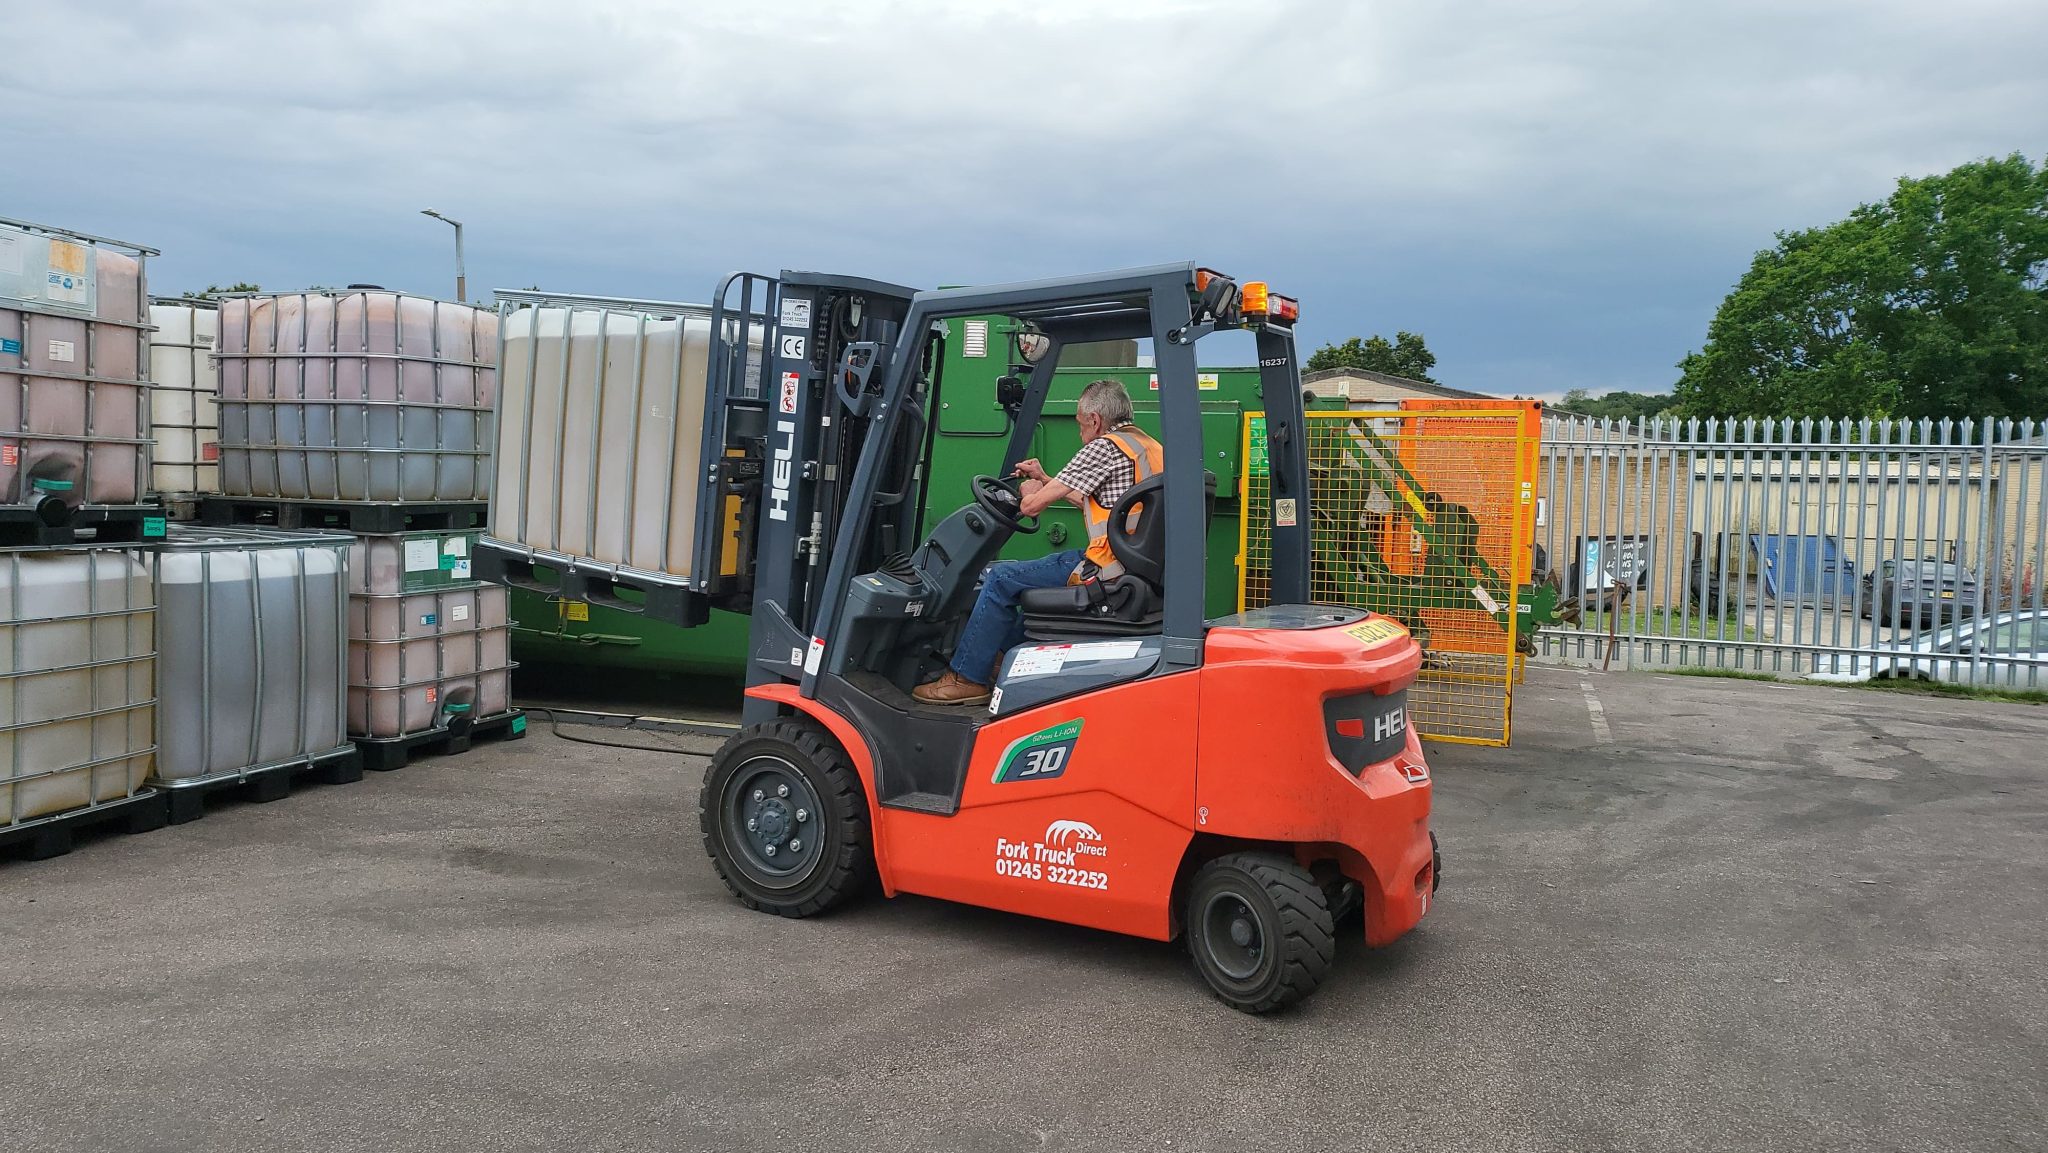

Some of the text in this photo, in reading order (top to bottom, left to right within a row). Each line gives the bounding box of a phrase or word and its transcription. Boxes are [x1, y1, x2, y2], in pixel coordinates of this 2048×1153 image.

[783, 338, 802, 356] CE
[1260, 358, 1287, 367] 16237
[769, 420, 795, 521] HELI
[1374, 704, 1407, 742] HEL
[1020, 746, 1067, 777] 30
[996, 838, 1107, 866] Fork Truck Direct
[995, 858, 1108, 890] 01245 322252
